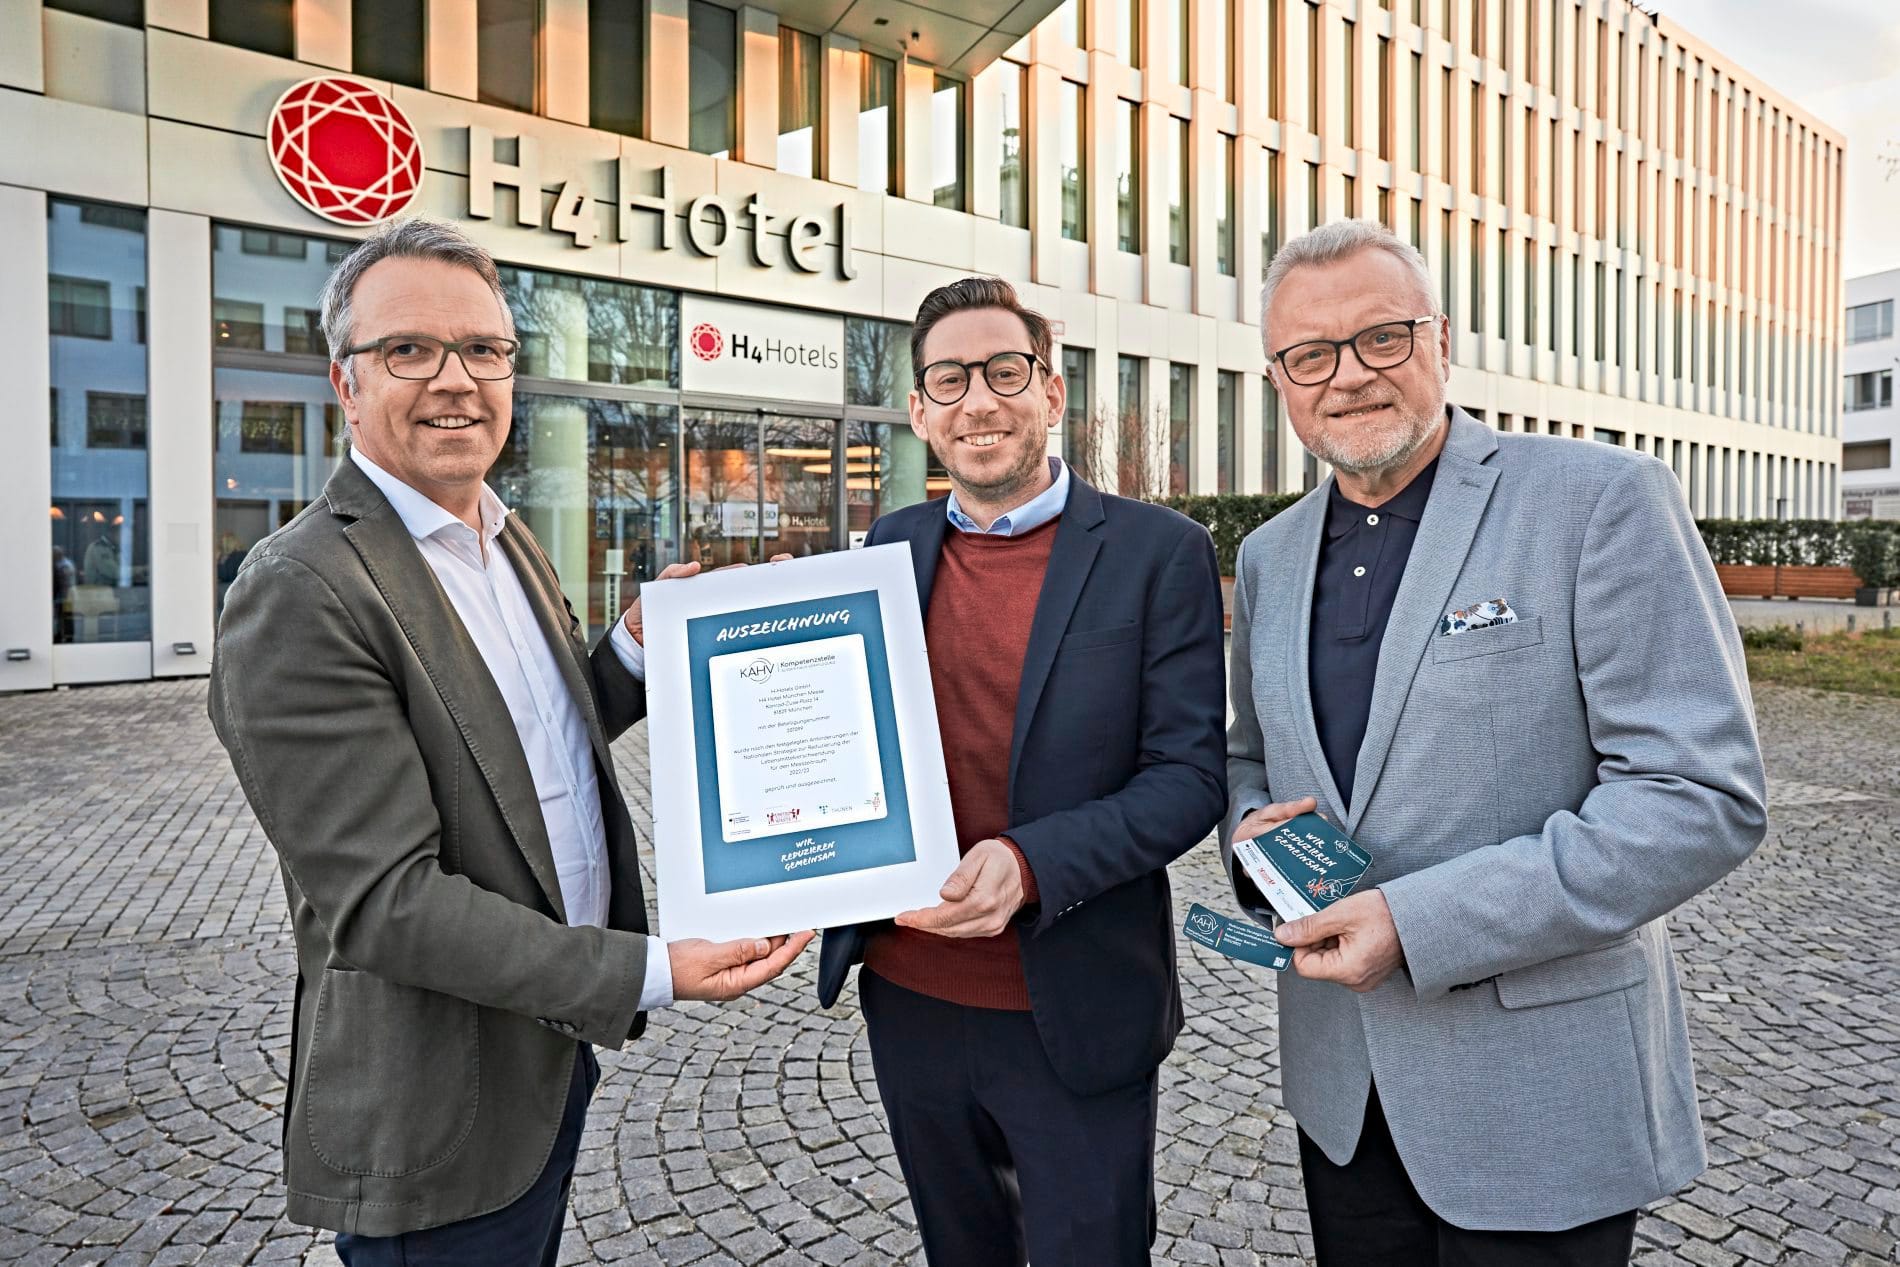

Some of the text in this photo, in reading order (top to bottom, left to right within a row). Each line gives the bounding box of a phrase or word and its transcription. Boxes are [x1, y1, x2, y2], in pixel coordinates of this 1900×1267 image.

[468, 126, 857, 281] H4Hotel
[731, 333, 839, 369] H4Hotels
[716, 609, 850, 642] AUSZEICHNUNG
[740, 664, 775, 678] KAHV
[780, 654, 835, 668] Kompetenzstelle
[781, 841, 835, 863] REDUZIEREN
[795, 838, 815, 849] WIR
[1280, 828, 1338, 868] REDUZIEREN
[1305, 832, 1325, 849] WIR
[784, 851, 836, 872] GEMEINSAM
[1274, 835, 1328, 876] GEMEINSAM
[1191, 913, 1219, 931] KAHV
